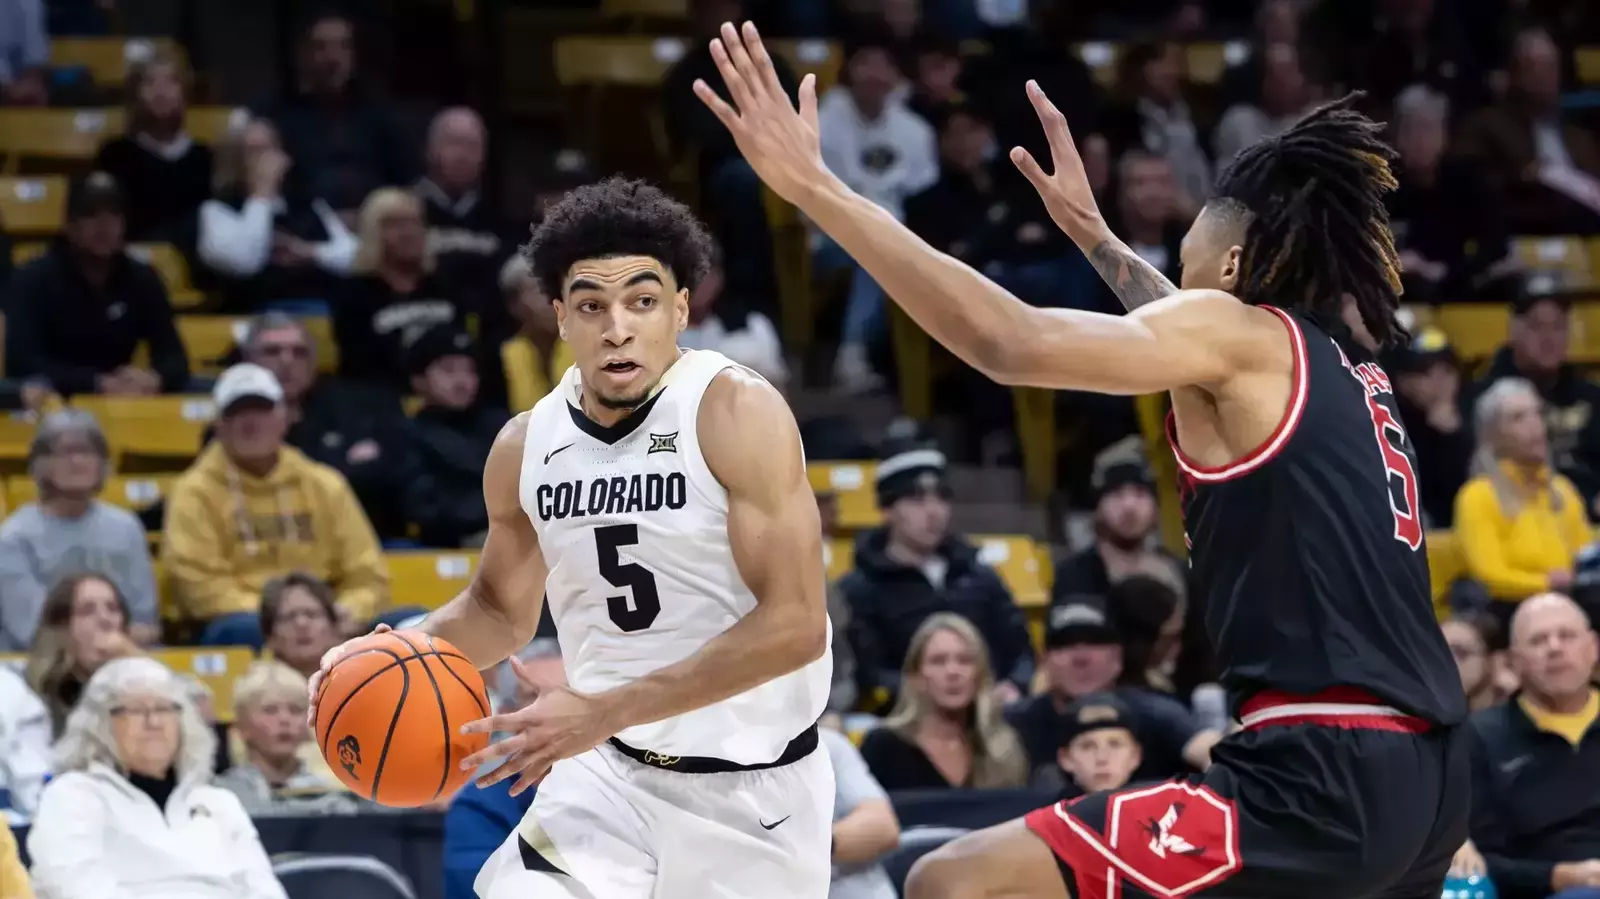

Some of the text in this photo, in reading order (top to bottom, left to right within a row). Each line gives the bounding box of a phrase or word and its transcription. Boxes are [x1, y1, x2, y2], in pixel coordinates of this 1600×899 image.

[536, 471, 687, 522] COLORADO
[1365, 388, 1422, 551] 5
[593, 523, 661, 633] 5
